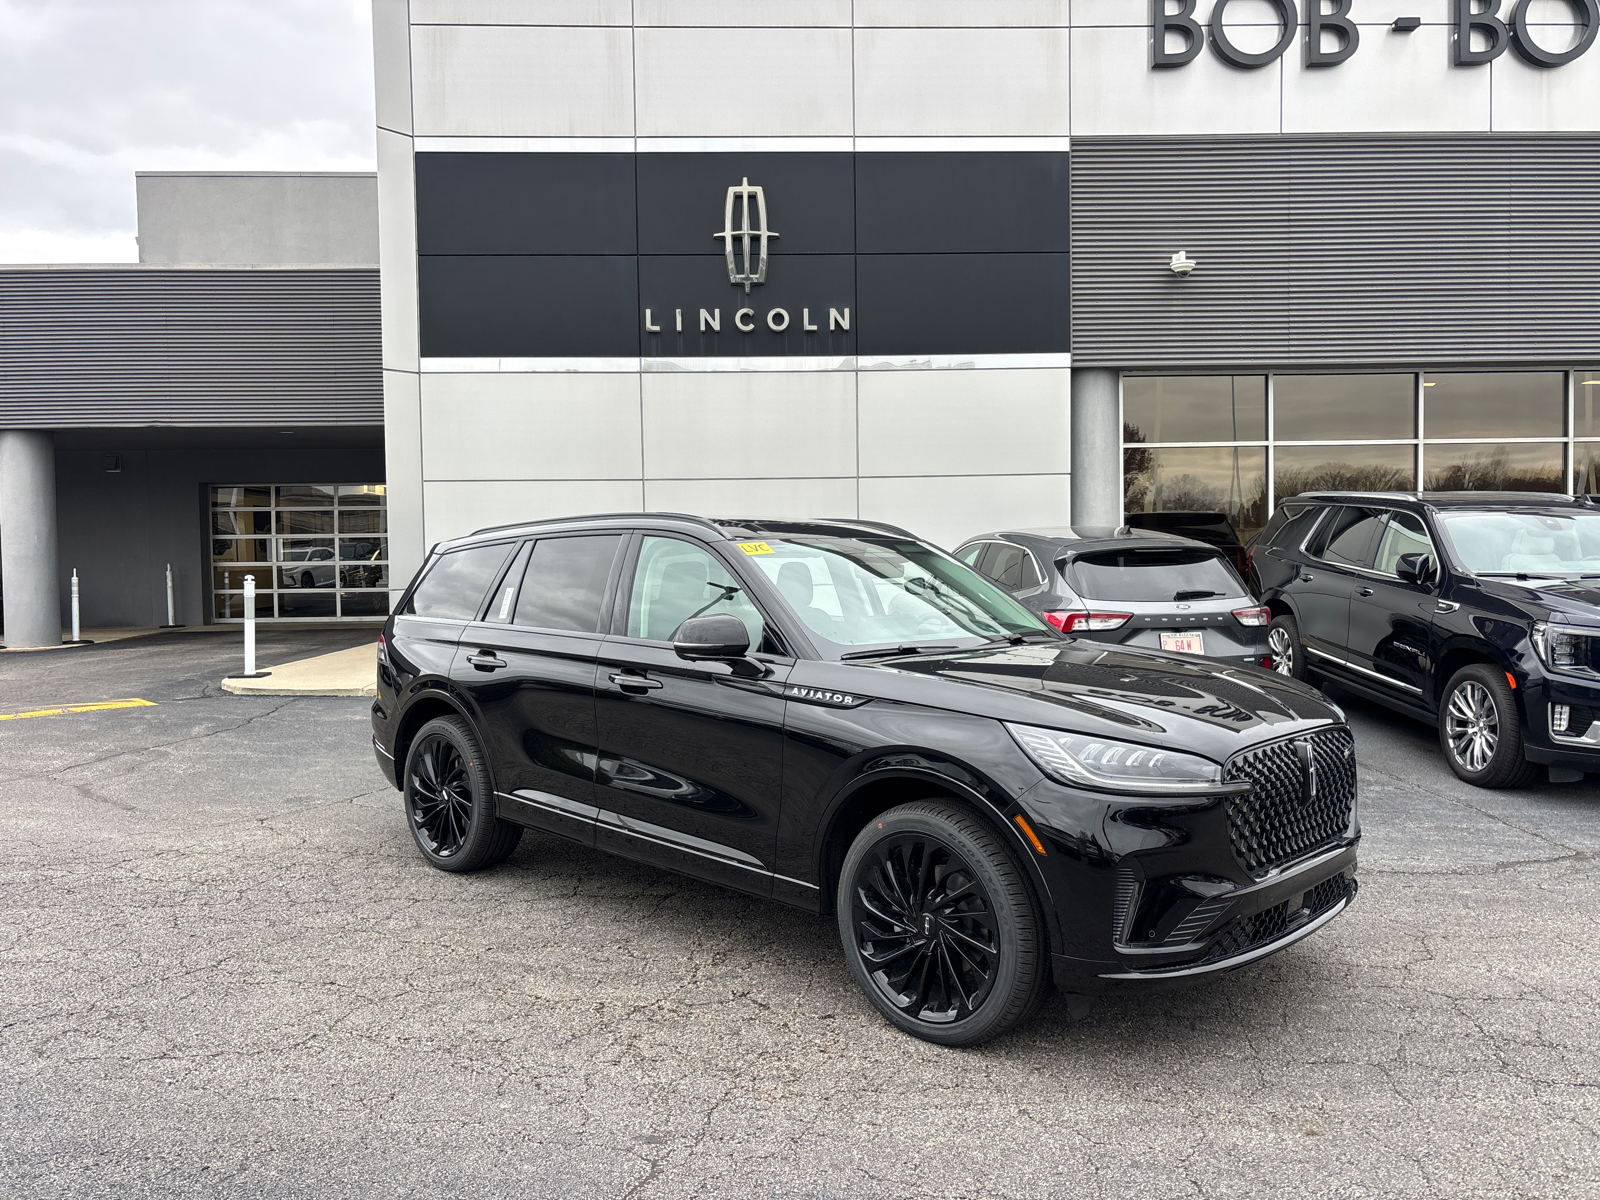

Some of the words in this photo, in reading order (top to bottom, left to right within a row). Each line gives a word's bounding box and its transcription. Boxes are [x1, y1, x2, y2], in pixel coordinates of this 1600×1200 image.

[1152, 0, 1359, 69] BOB
[1454, 0, 1600, 68] BO
[645, 308, 850, 332] LINCOLN
[740, 543, 770, 553] LVC
[792, 688, 853, 704] AVIATOR
